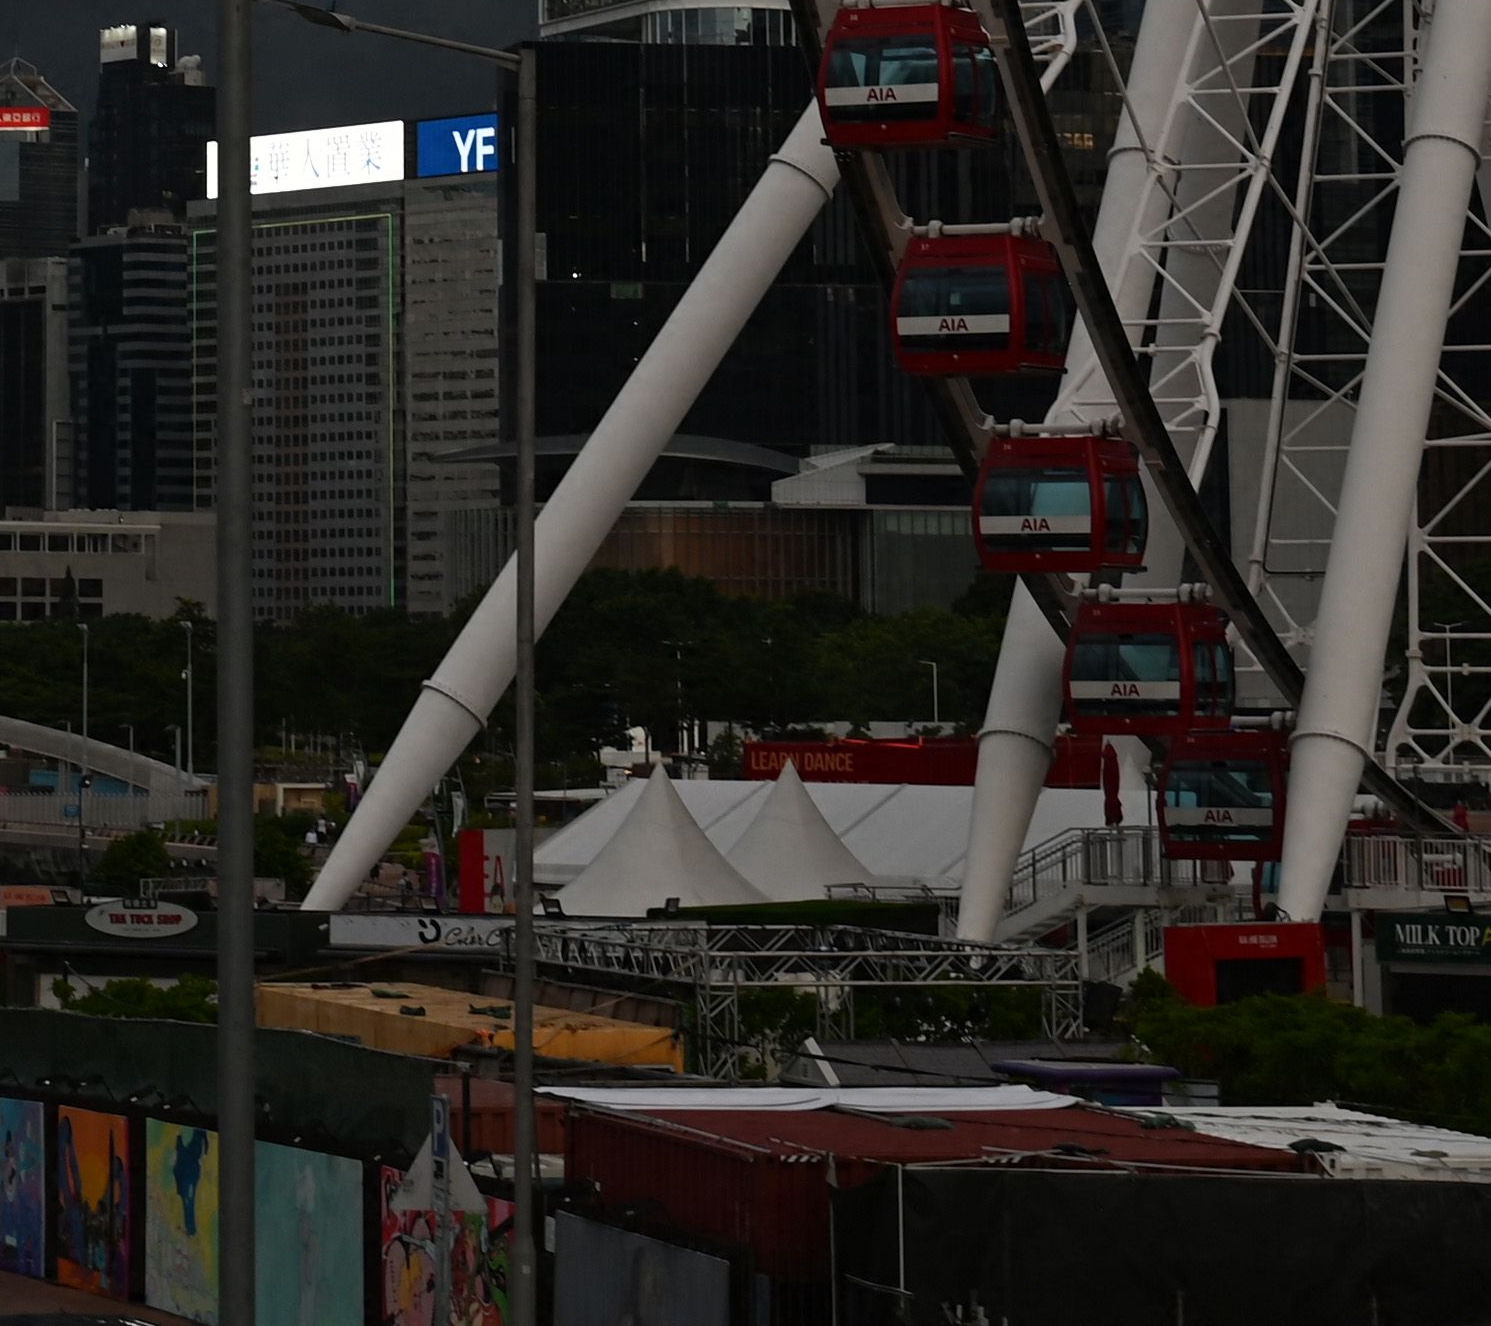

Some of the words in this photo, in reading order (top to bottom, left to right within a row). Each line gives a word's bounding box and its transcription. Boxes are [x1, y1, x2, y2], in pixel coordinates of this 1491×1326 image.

[867, 87, 897, 102] AIA
[452, 127, 496, 173] YF
[939, 318, 968, 332] AIA
[1021, 518, 1051, 532] AIA
[1111, 683, 1140, 697] AIA
[751, 751, 799, 771] LEARN
[804, 752, 854, 772] DANCE
[1204, 809, 1234, 823] AIA
[157, 914, 183, 925] SHOP
[1394, 923, 1441, 945] MILK
[1444, 924, 1481, 947] TOP
